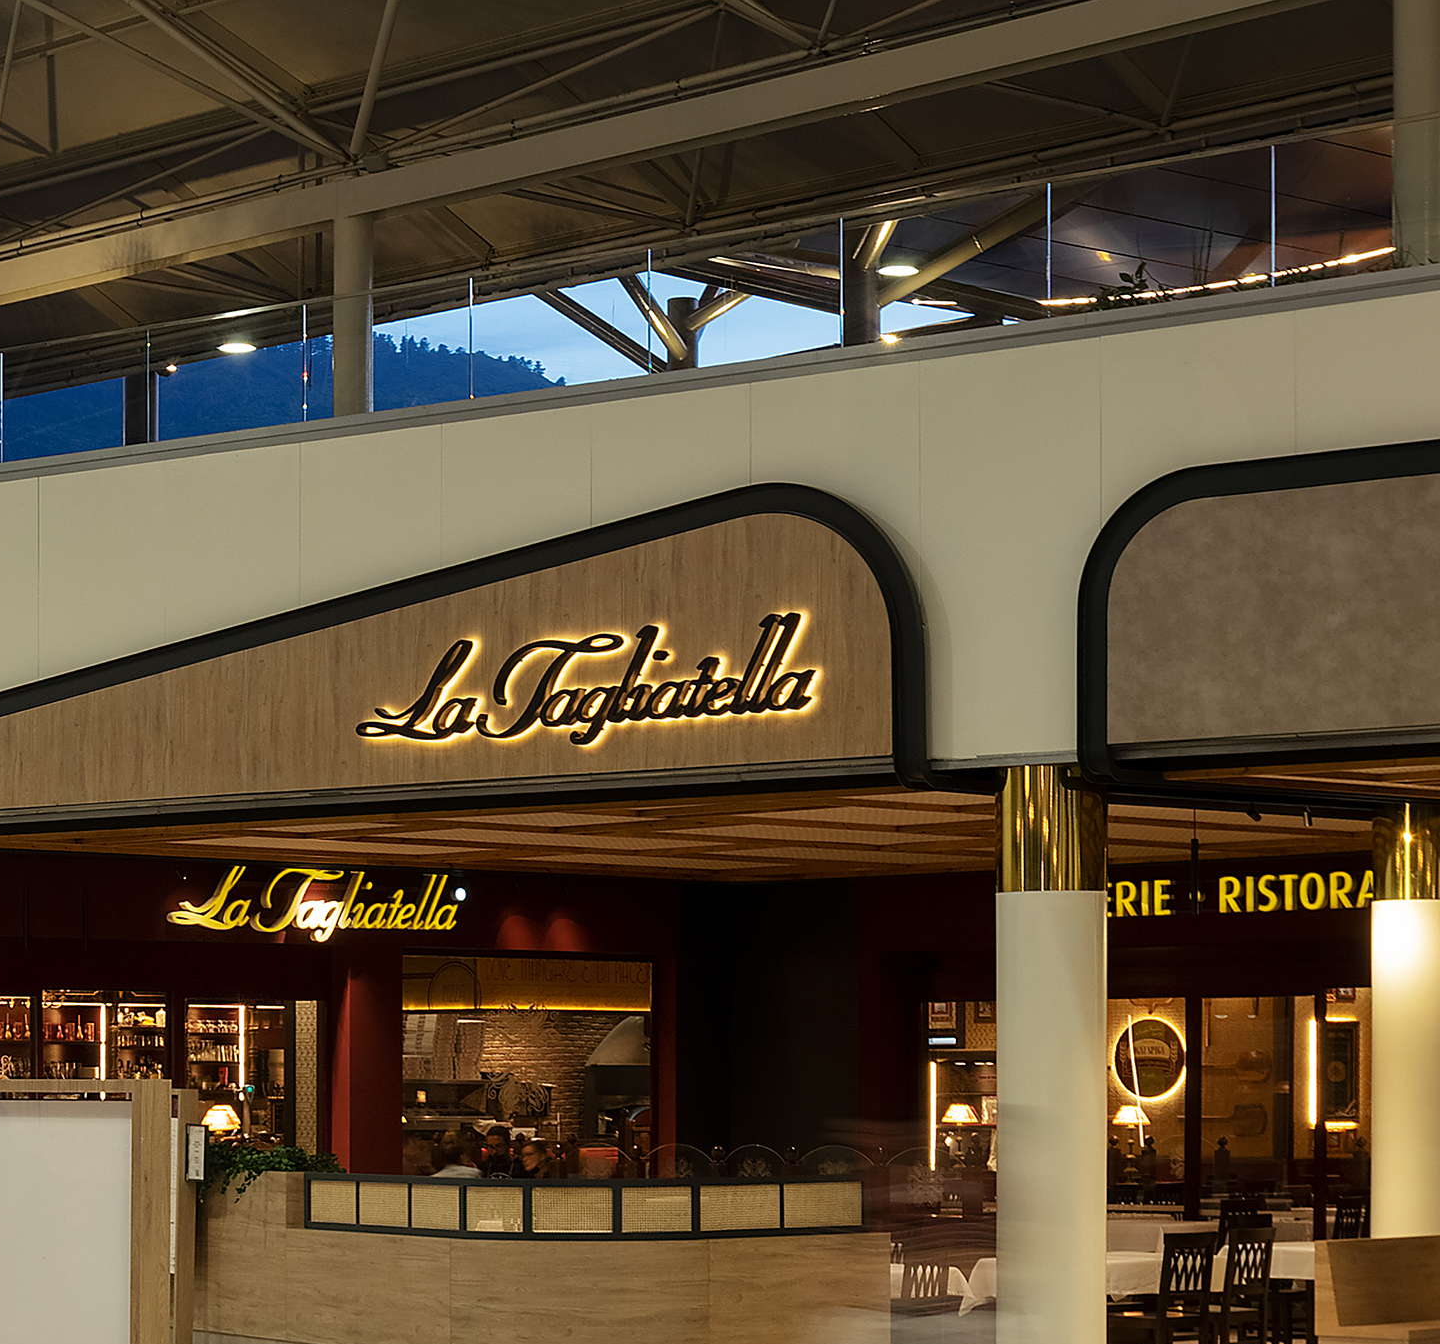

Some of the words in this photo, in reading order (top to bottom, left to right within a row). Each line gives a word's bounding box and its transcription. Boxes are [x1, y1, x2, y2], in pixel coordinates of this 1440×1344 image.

[356, 638, 476, 740] La
[476, 612, 818, 746] Tagliatella
[166, 865, 250, 931] La
[250, 868, 459, 943] Tagliatella
[1107, 879, 1173, 918] RIE
